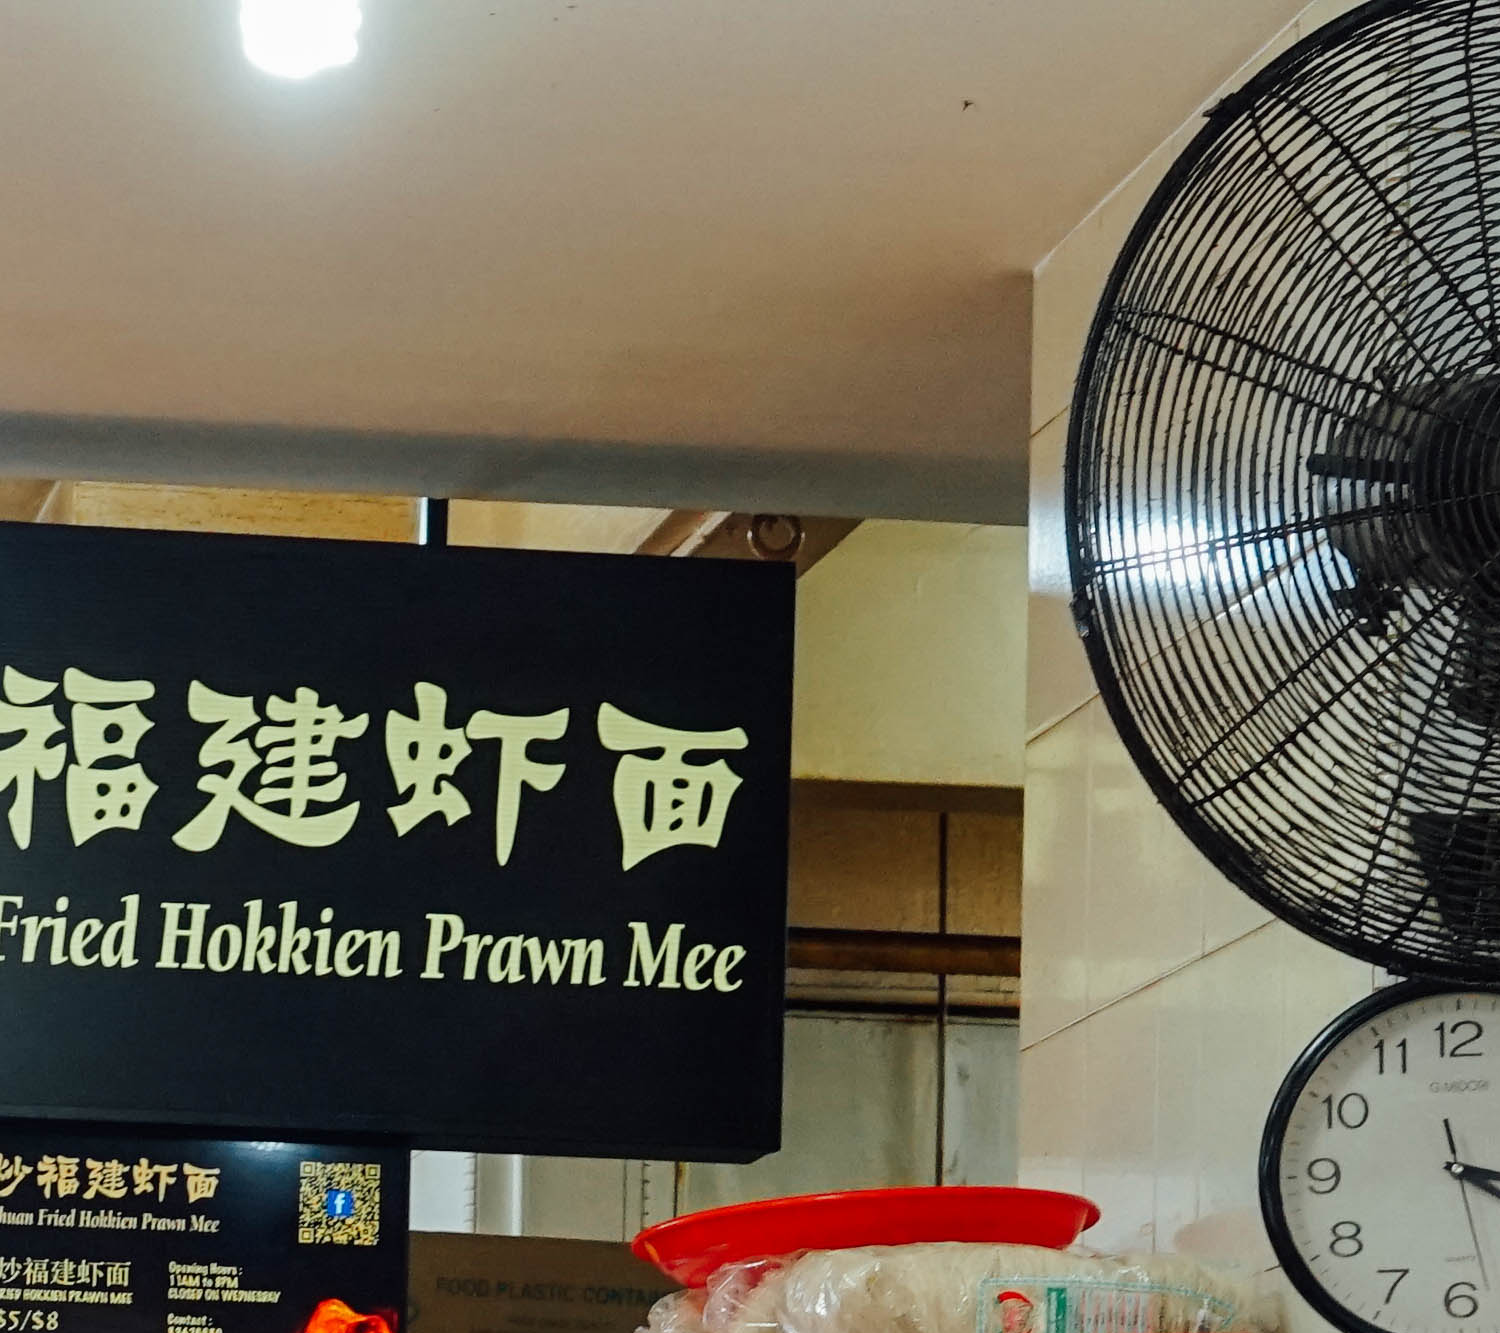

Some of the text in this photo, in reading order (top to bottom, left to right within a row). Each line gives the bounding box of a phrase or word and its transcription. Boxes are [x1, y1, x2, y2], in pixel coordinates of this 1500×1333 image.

[155, 902, 401, 981] Hokkien
[421, 910, 605, 988] Prawn
[624, 919, 748, 993] Mee
[1374, 1037, 1408, 1074] 11
[1435, 1019, 1483, 1058] 12
[1322, 1092, 1369, 1129] 10
[1306, 1157, 1341, 1194] 9
[37, 1208, 76, 1228] Fried
[79, 1209, 138, 1230] Hokkien
[141, 1211, 186, 1231] Prawn
[189, 1214, 221, 1233] Mee
[1329, 1220, 1363, 1258] 8
[1377, 1268, 1410, 1304] 7
[1443, 1281, 1479, 1318] 6
